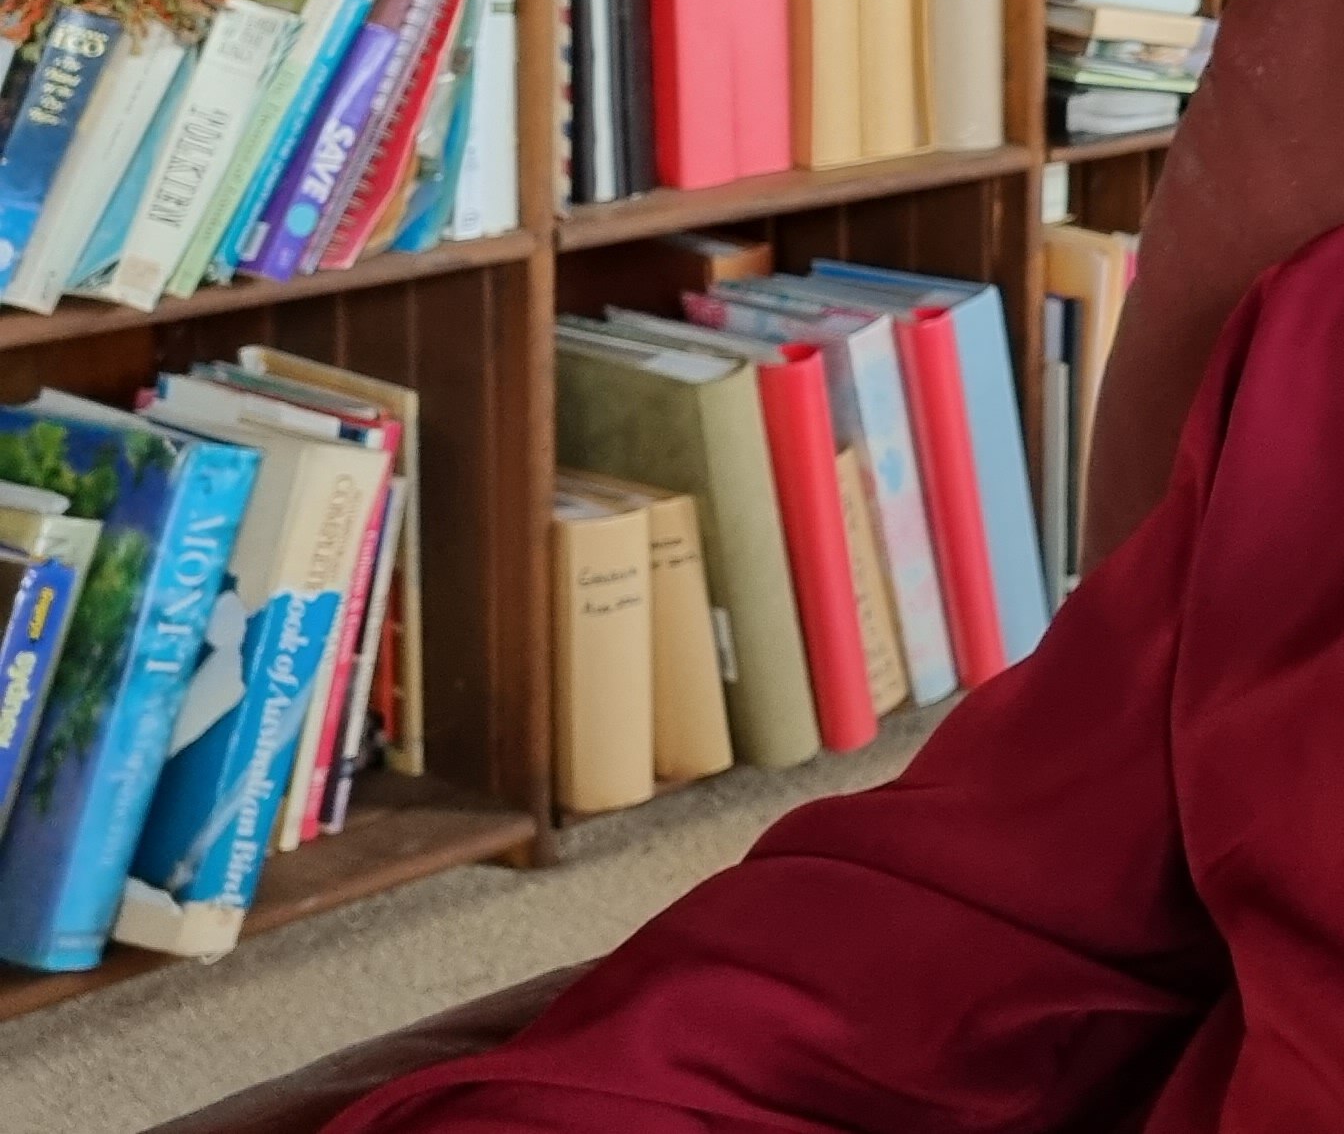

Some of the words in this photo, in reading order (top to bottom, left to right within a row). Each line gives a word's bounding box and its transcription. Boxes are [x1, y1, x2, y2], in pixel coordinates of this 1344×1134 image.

[147, 104, 230, 227] TOLKIEN
[301, 119, 356, 204] SAVE
[145, 510, 226, 674] MONET
[277, 594, 309, 653] ook
[266, 653, 300, 689] of
[235, 680, 292, 837] Australian
